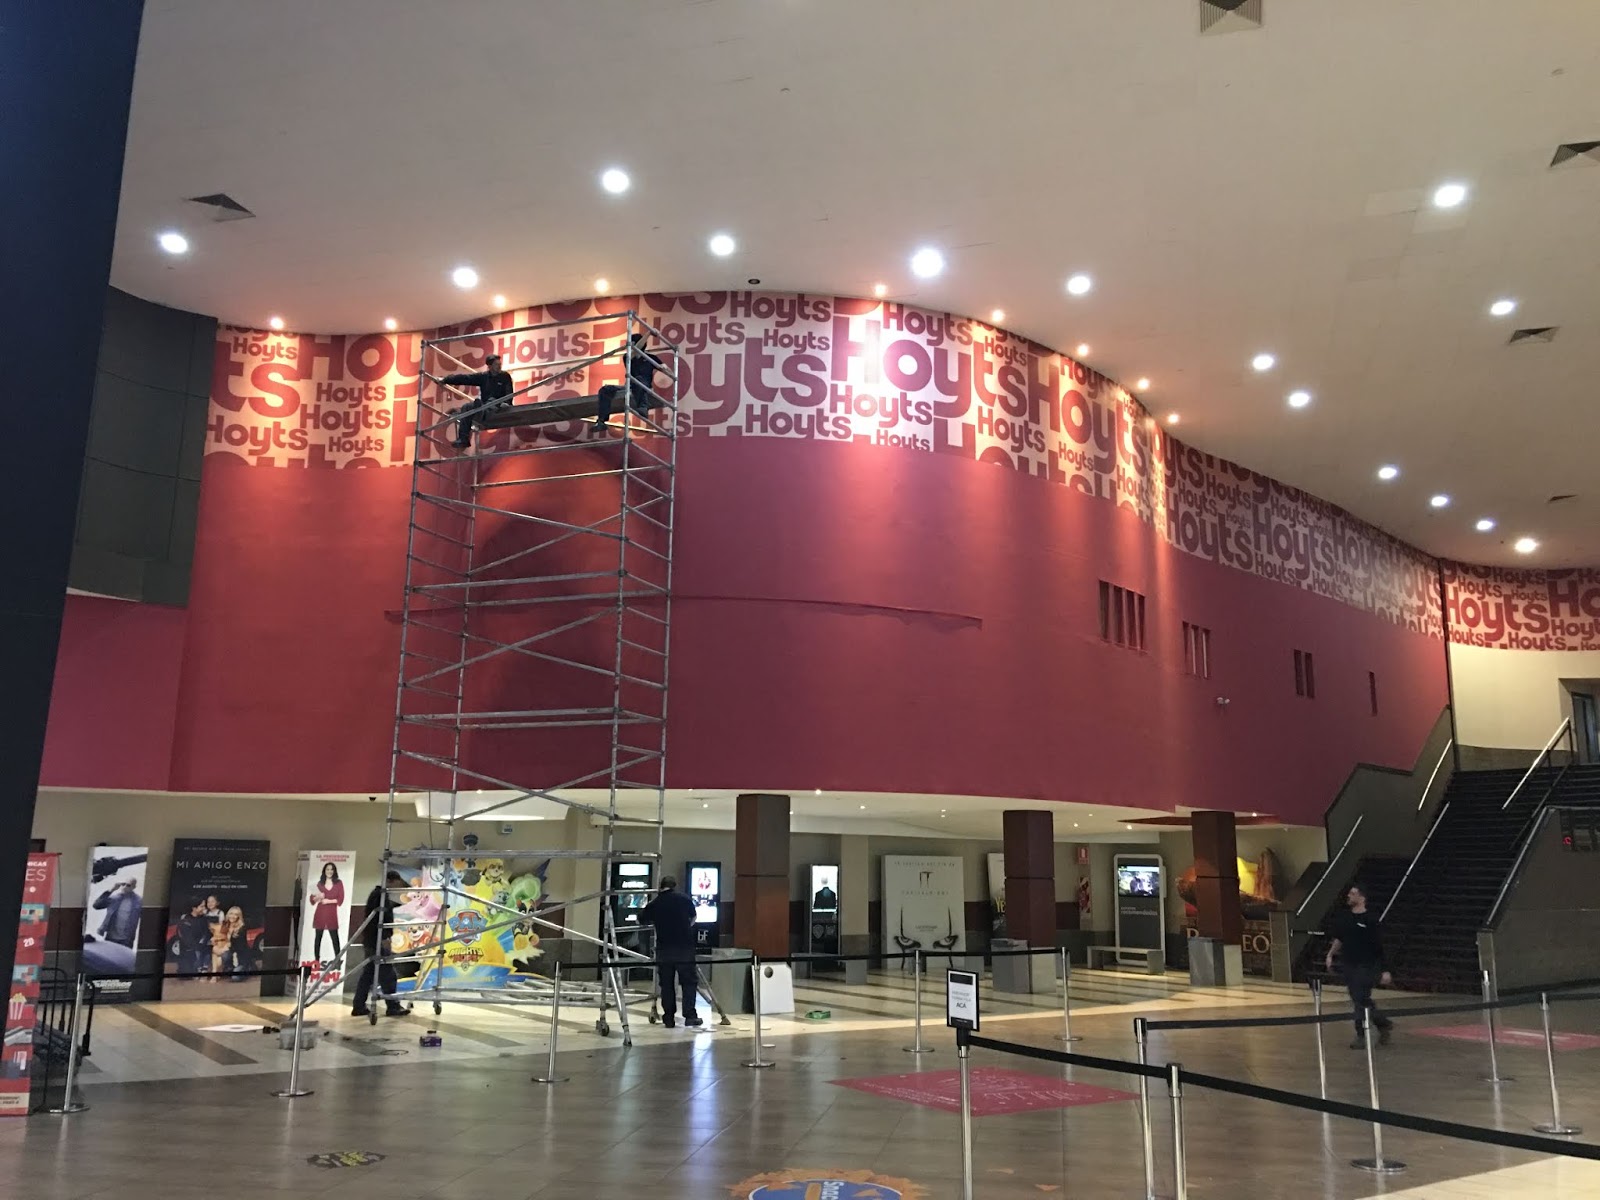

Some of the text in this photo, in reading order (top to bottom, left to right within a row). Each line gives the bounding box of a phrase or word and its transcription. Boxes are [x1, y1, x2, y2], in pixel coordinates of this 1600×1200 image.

[729, 291, 832, 328] Hoyts
[881, 302, 974, 348] Hoyts
[232, 337, 298, 362] Hoyts
[498, 328, 590, 366] Hoyts
[762, 328, 830, 358] Hoyts
[984, 335, 1027, 366] Hoyts
[831, 316, 1030, 422] Hoyts
[317, 381, 387, 409] Hoyts
[830, 384, 933, 427] Hoyts
[300, 403, 392, 439] Hoyts
[744, 404, 853, 439] Hoyts
[978, 405, 1046, 453] Hoyts
[328, 436, 385, 458] Hoyts
[1458, 576, 1503, 600] Hoyts
[1445, 584, 1550, 642] Hoyts
[176, 861, 267, 870] MI AMIGO ENZO
